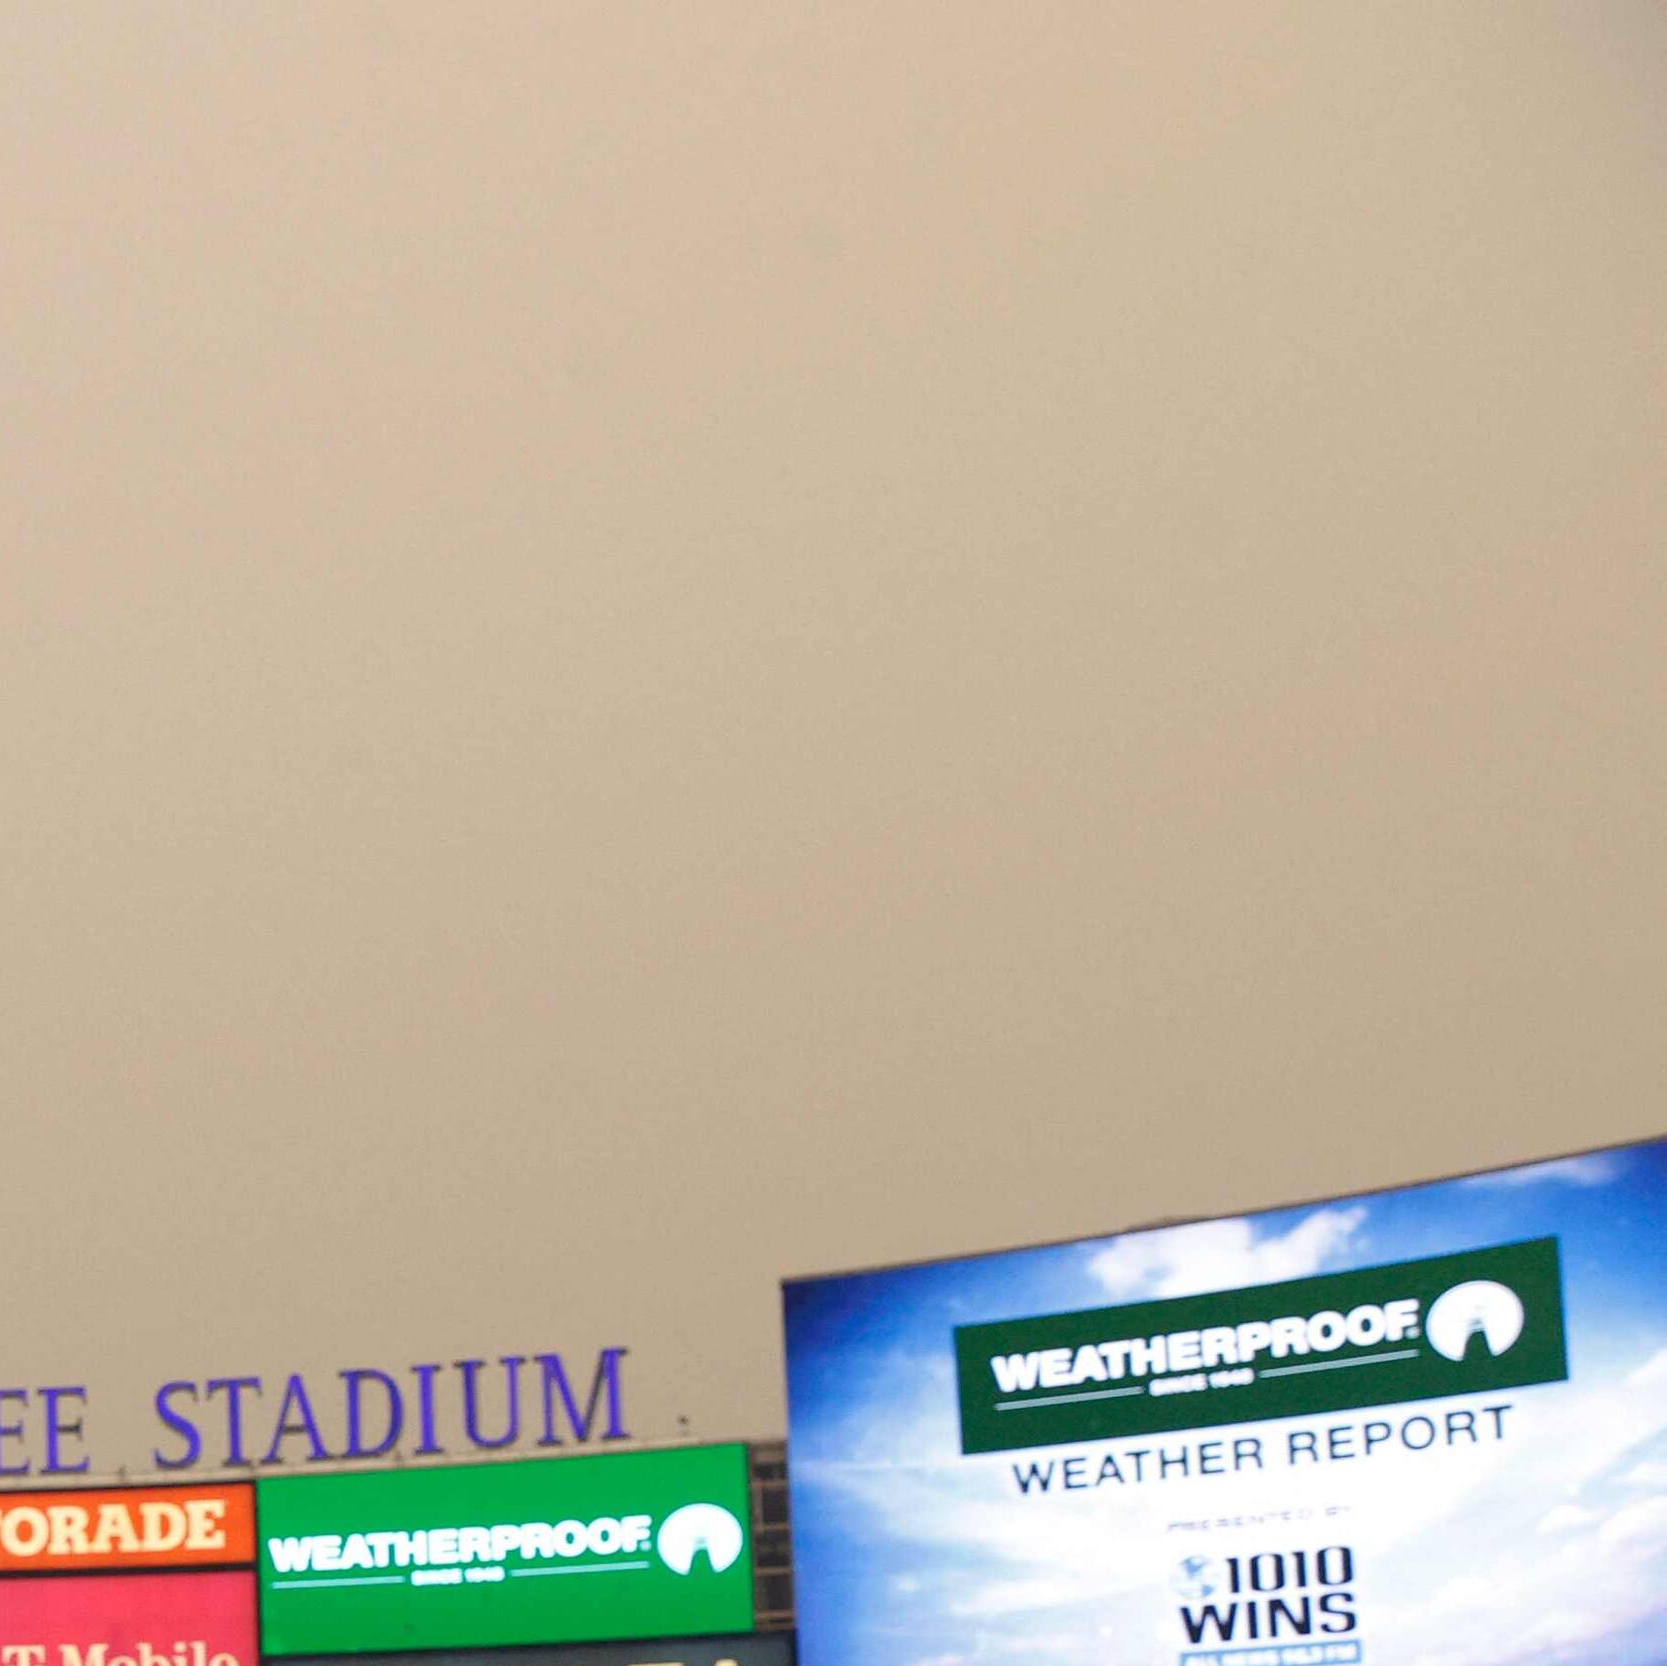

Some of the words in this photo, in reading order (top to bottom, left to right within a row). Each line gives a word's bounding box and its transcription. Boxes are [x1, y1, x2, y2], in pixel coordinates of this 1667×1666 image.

[990, 1297, 1421, 1394] WEATHERPROOF
[151, 1347, 631, 1471] STADIUM
[1012, 1437, 1264, 1495] WEATHER
[1286, 1405, 1513, 1465] REPORT
[269, 1516, 652, 1572] WEATHERPROOF
[1226, 1545, 1355, 1594] 1010
[1179, 1592, 1357, 1645] WINS
